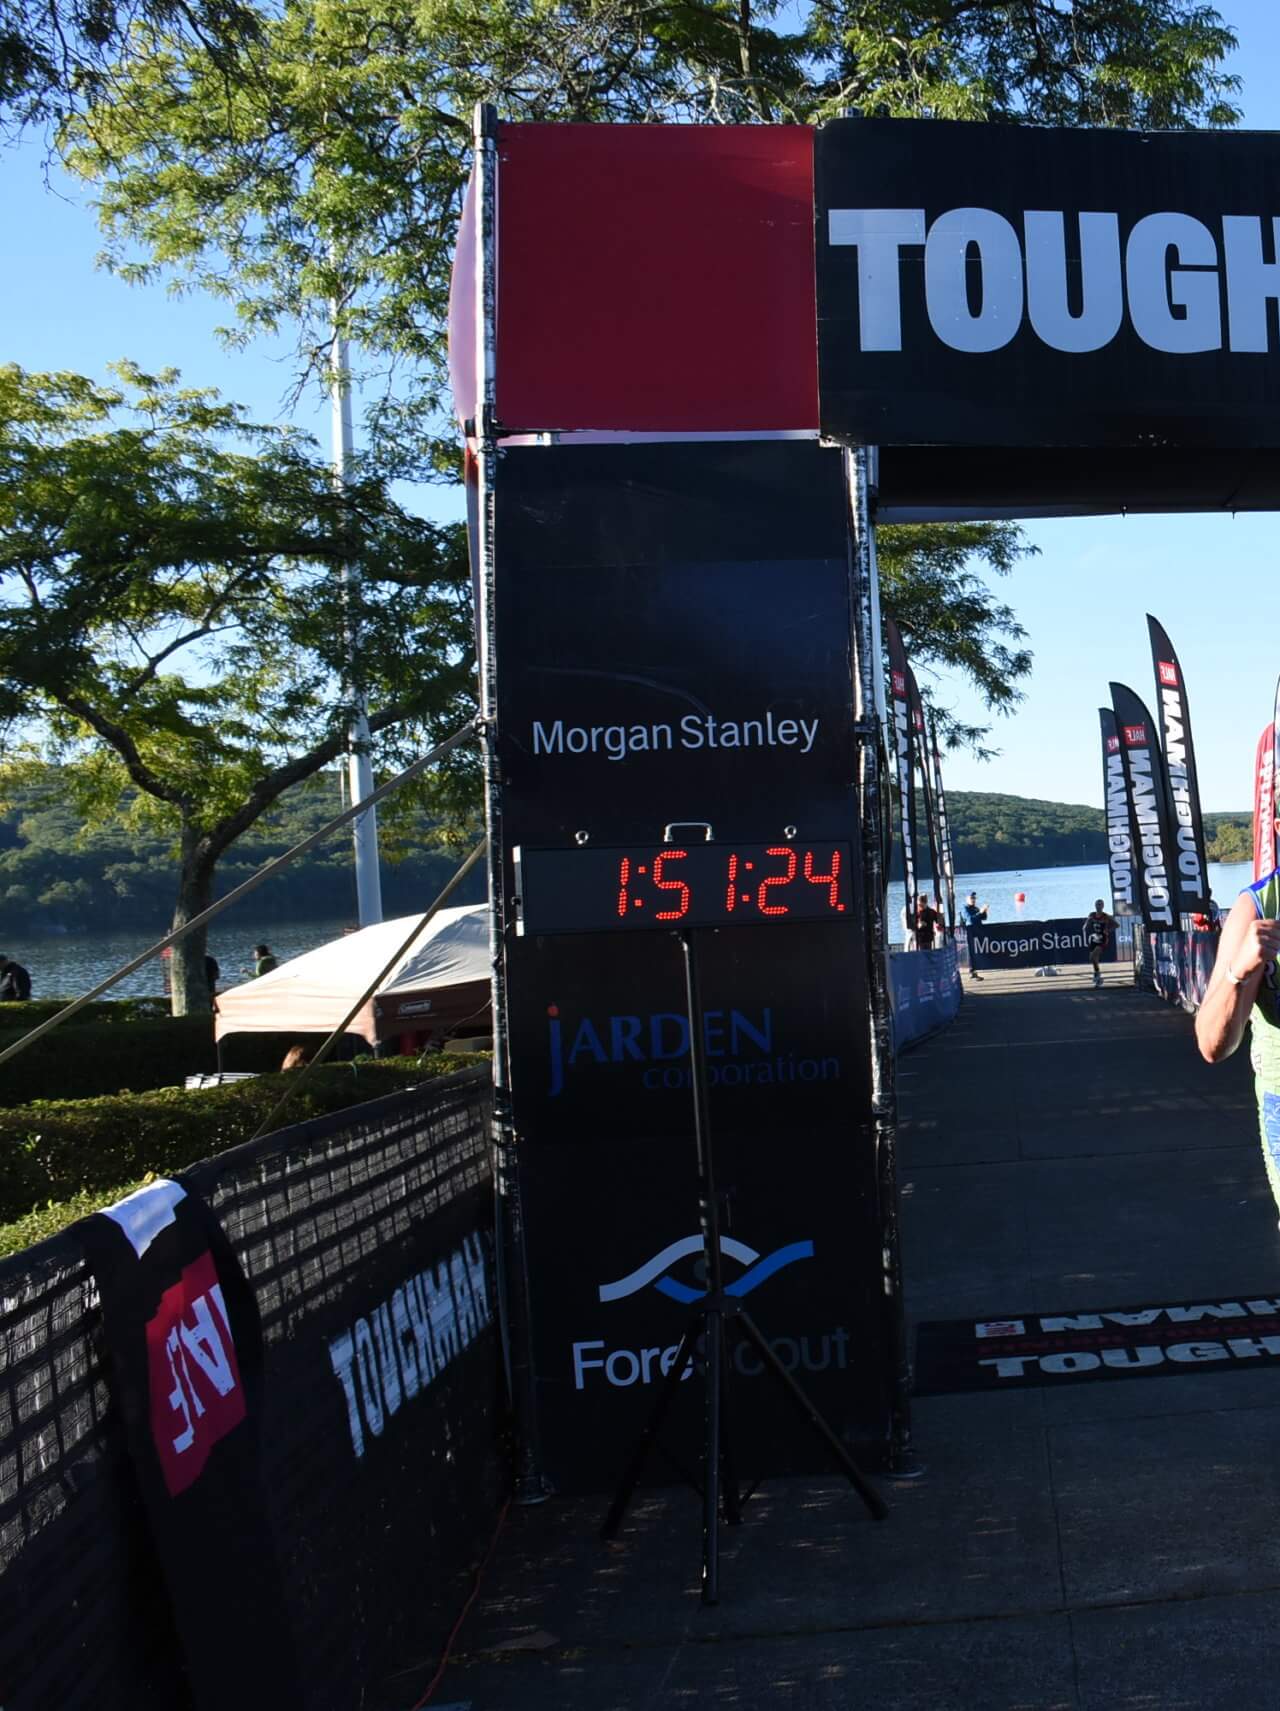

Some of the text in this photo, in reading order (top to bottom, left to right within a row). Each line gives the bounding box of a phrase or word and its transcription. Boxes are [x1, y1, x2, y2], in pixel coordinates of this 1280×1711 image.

[532, 711, 820, 760] Morgan Stanley
[973, 928, 1099, 957] Morgan Stanl
[642, 1051, 841, 1090] coporation
[329, 1231, 492, 1458] TOUGHMAN
[572, 1326, 850, 1390] Forecout
